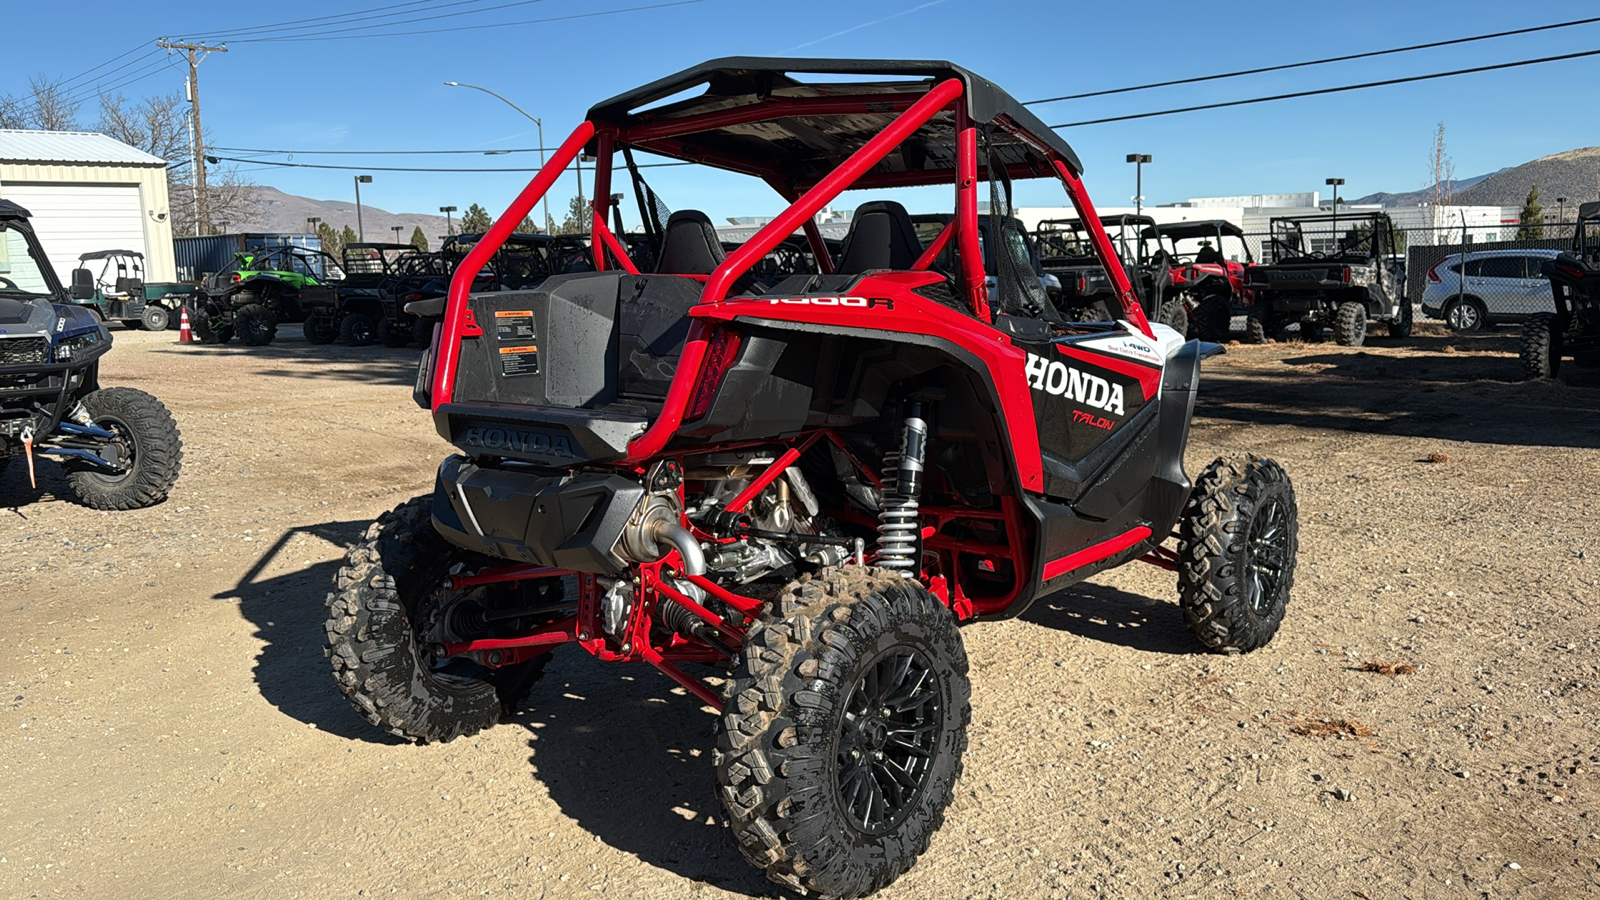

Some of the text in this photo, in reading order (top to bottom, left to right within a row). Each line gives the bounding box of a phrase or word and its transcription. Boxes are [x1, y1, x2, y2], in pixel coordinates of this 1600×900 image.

[56, 317, 66, 332] 1000
[1024, 352, 1125, 416] HONDA
[1072, 409, 1115, 430] TALON
[465, 426, 576, 459] HONDA
